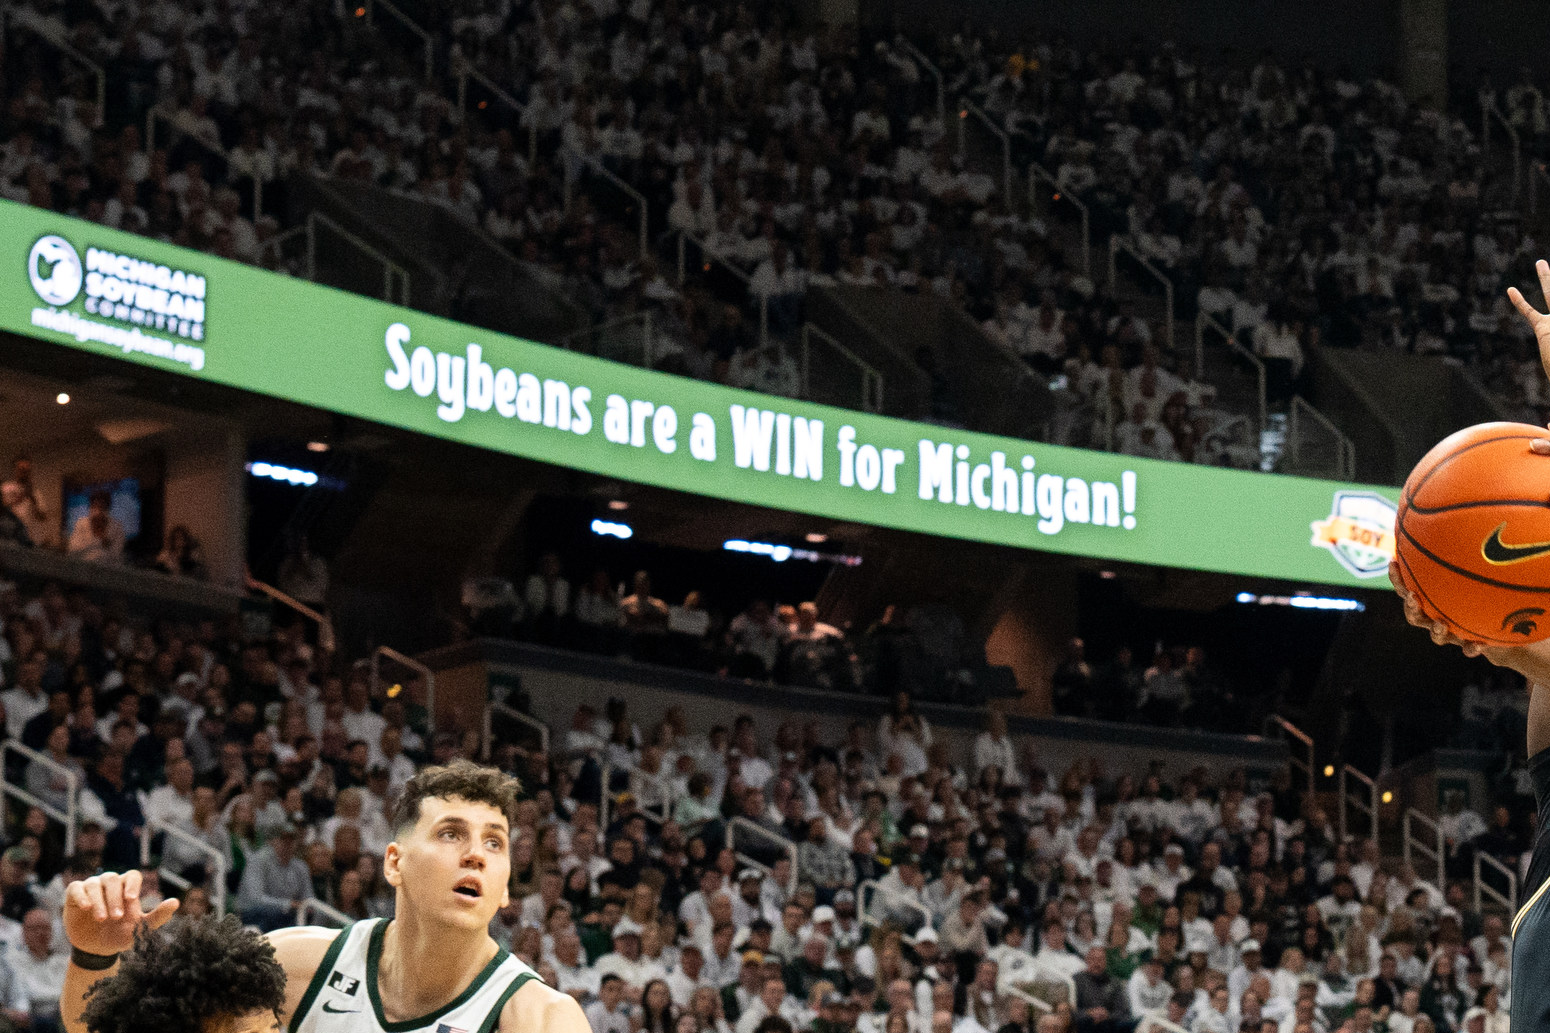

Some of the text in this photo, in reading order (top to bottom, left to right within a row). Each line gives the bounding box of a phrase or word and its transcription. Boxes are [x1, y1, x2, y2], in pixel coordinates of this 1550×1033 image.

[86, 247, 206, 300] MICHIGAN
[86, 271, 205, 324] SOYBEAN
[385, 323, 1137, 535] Soybeans are a WIN for Michigan!
